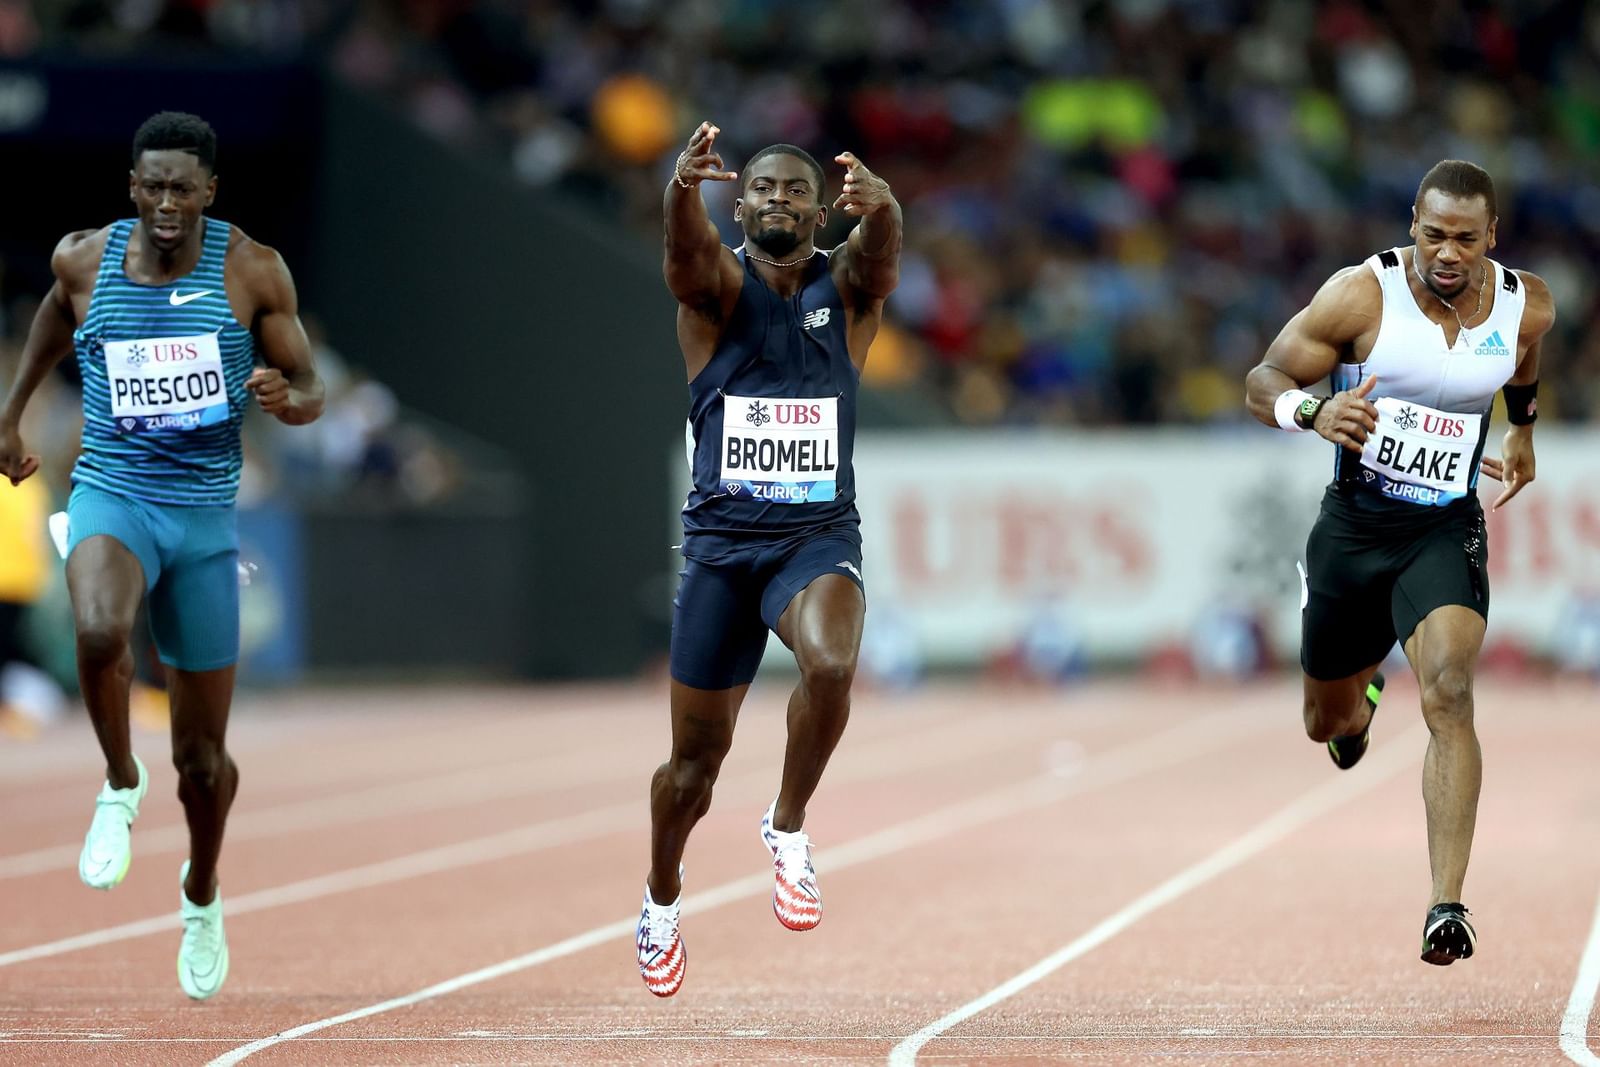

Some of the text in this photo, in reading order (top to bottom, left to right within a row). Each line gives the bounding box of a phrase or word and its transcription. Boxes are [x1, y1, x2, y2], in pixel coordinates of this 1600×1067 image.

[153, 343, 198, 362] UBS
[1475, 347, 1510, 356] adidas
[115, 370, 220, 406] PRESCOD
[144, 412, 200, 430] ZURICH
[774, 404, 821, 425] UBS
[1423, 413, 1465, 438] UBS
[726, 437, 835, 473] BROMELL
[1376, 435, 1462, 482] BLAKE
[752, 485, 809, 500] ZURICH
[1382, 480, 1440, 504] ZURICH
